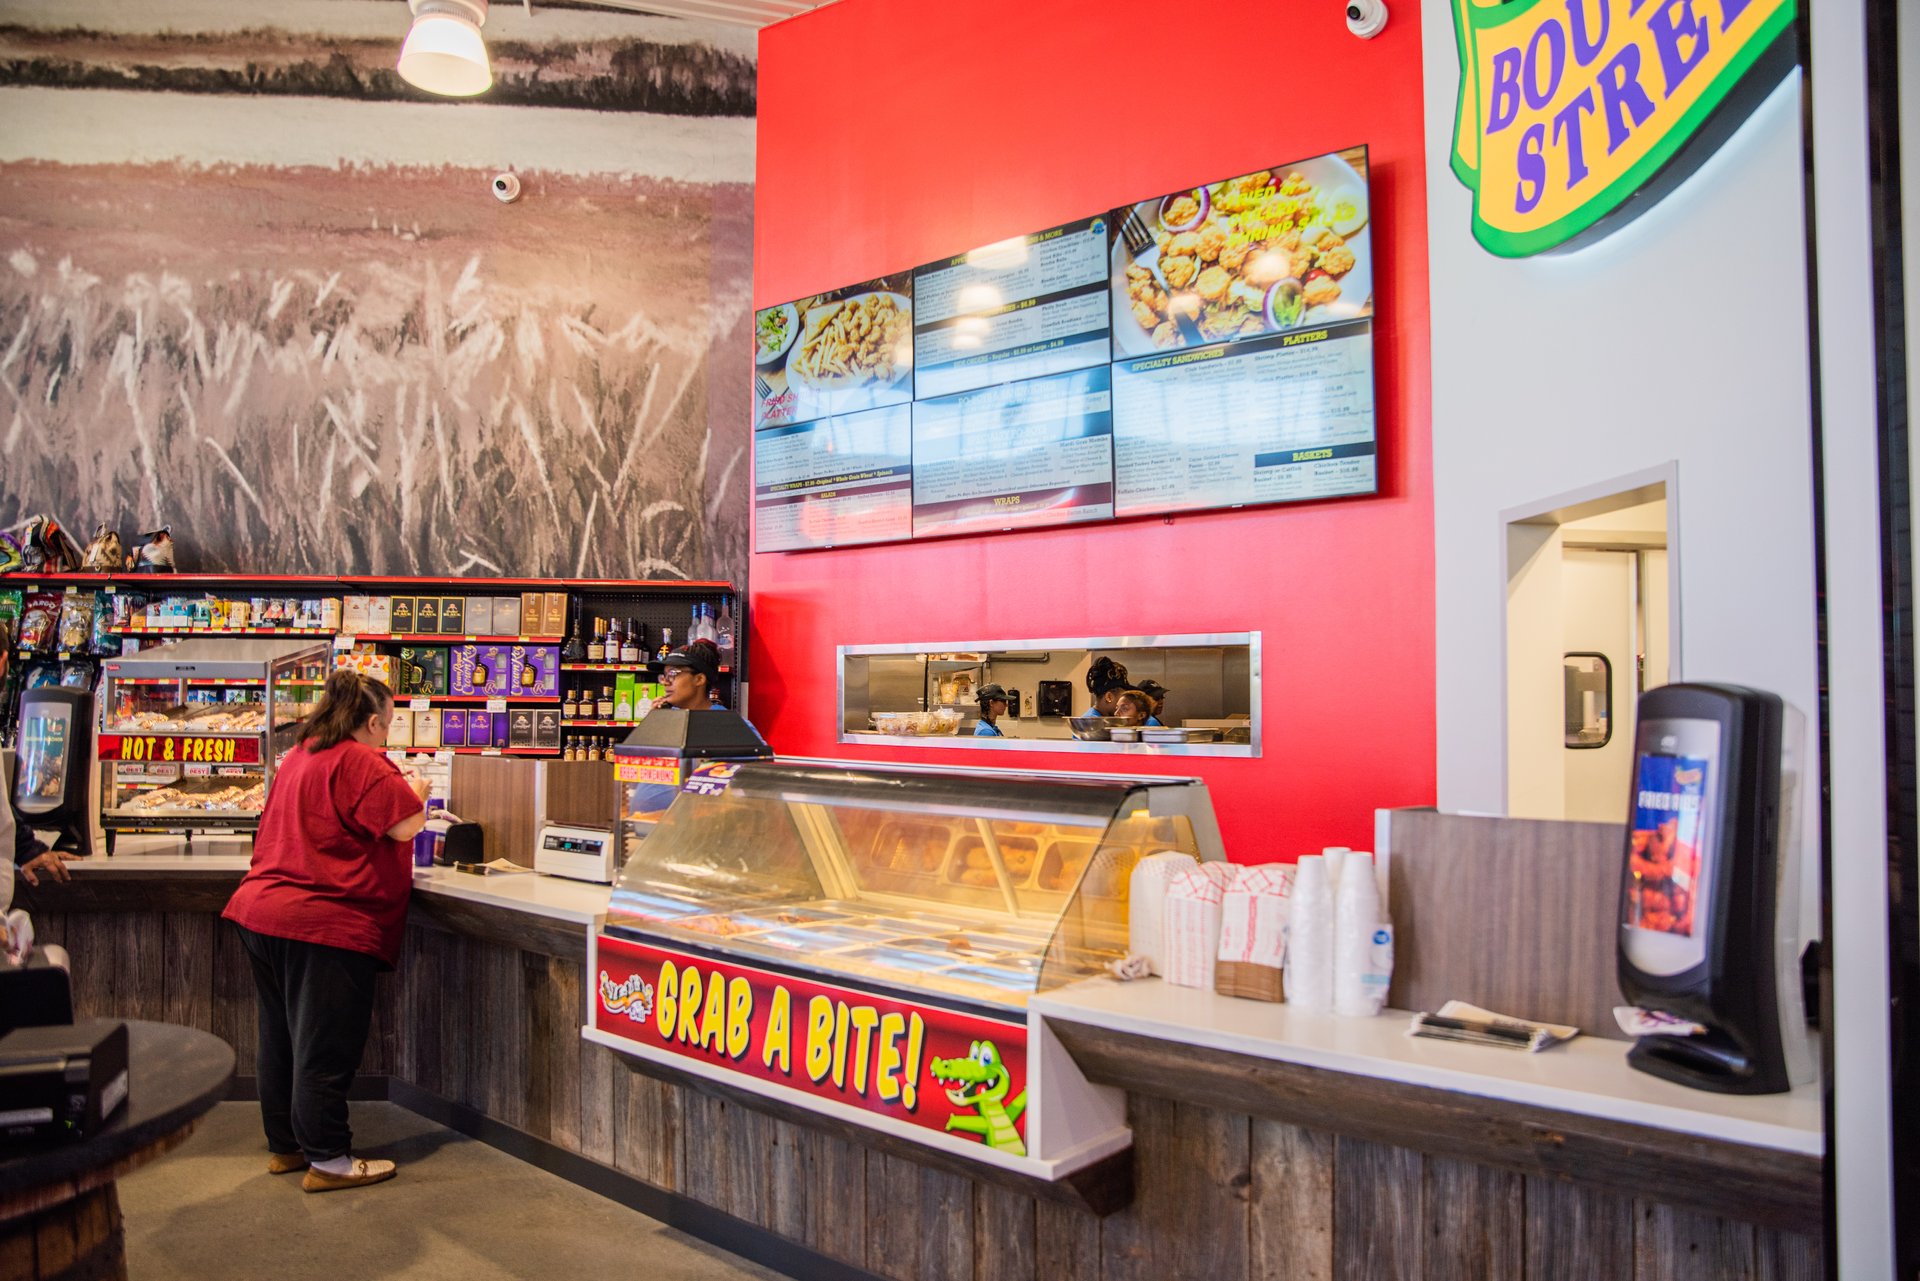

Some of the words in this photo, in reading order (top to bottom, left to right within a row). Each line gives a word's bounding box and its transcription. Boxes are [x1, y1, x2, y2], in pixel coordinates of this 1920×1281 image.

[1486, 0, 1646, 135] BOU
[1515, 0, 1750, 214] STRE
[1283, 330, 1328, 346] PLATTERS
[1132, 357, 1172, 372] SPECIALTY
[1172, 348, 1224, 365] SANDWICHES
[994, 496, 1020, 506] WRAPS
[122, 736, 156, 761] HOT
[163, 737, 174, 760] &
[182, 738, 236, 763] FRESH
[656, 960, 753, 1059] GRAB
[762, 985, 791, 1074] A
[806, 994, 924, 1110] BITE!
